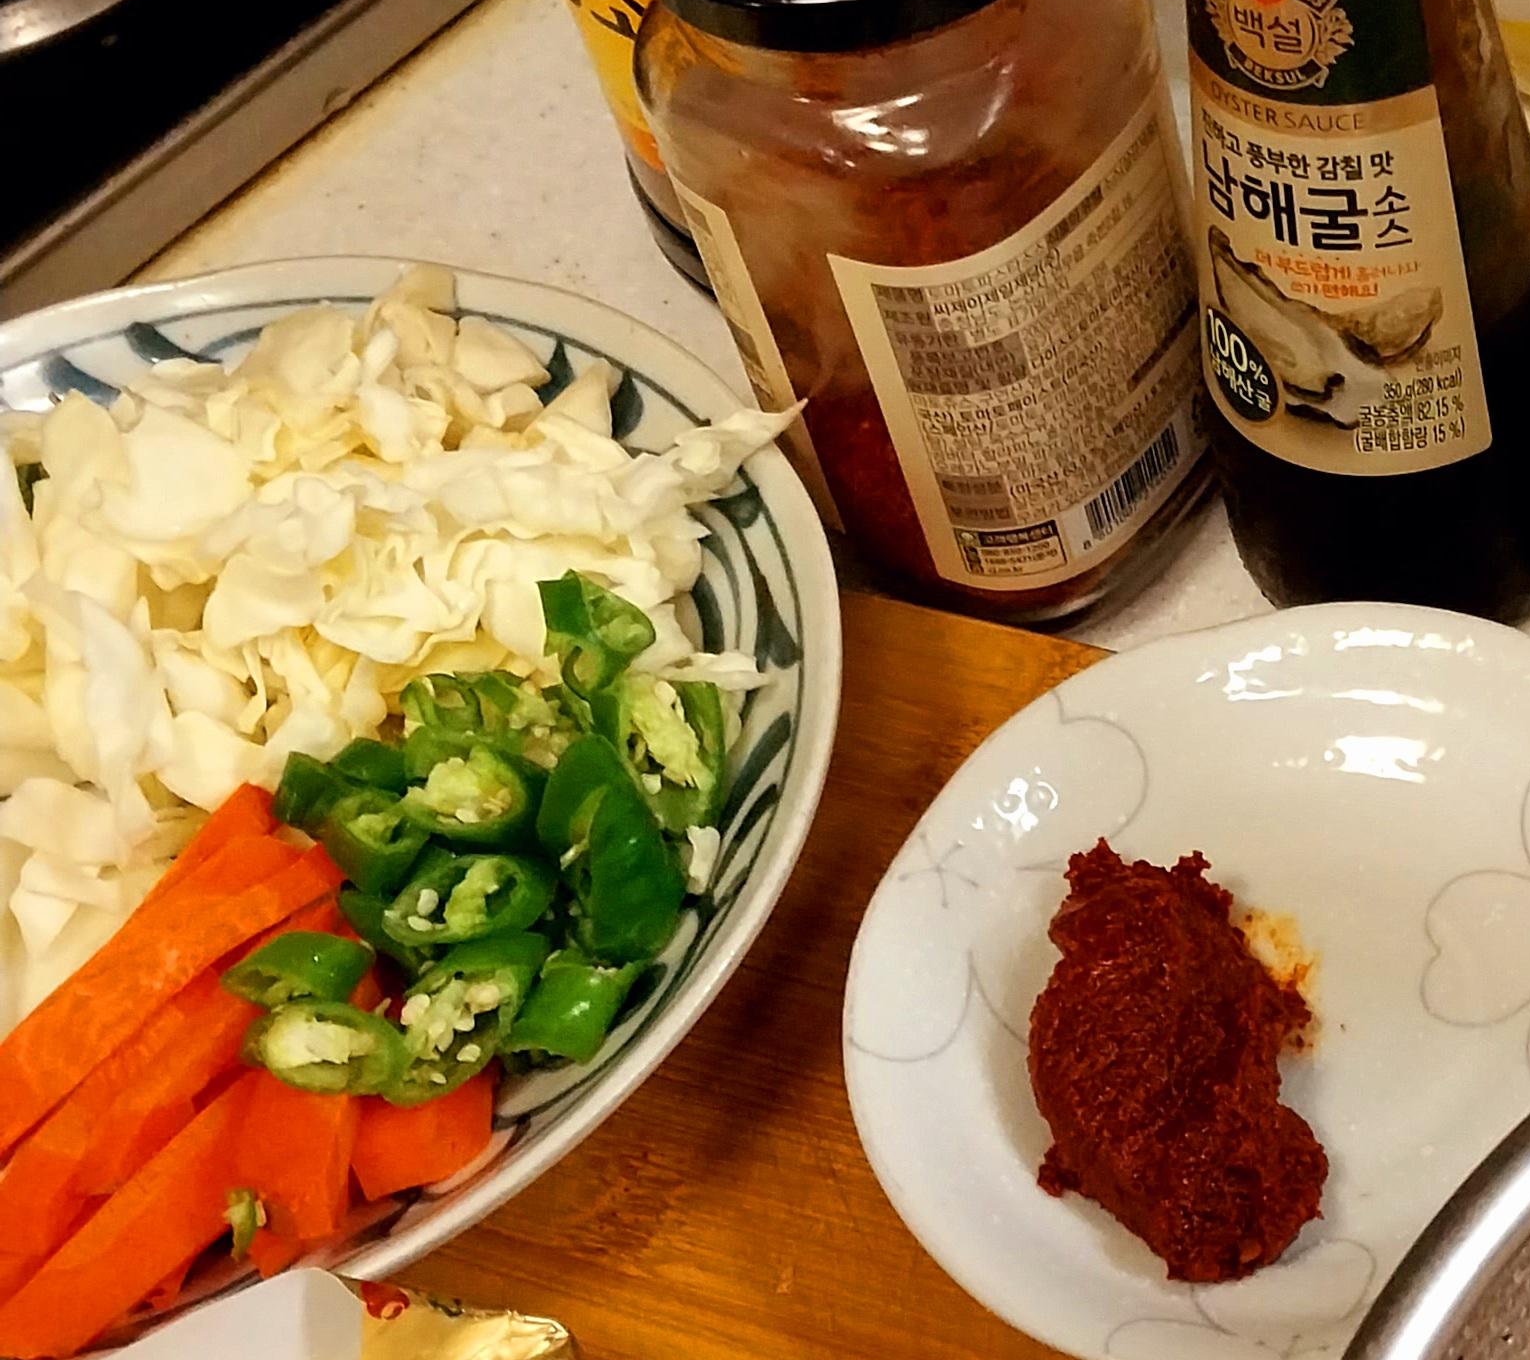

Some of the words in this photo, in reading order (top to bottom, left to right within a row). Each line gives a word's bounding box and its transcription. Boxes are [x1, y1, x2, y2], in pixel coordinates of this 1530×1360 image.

[1233, 5, 1303, 55] 백설
[1210, 79, 1280, 127] OYSTER
[1283, 111, 1367, 133] SAUCE
[1246, 140, 1311, 180] 풍부한
[1315, 154, 1364, 182] 감칠
[1369, 149, 1395, 179] 맛
[1201, 138, 1370, 252] 남해굴
[1372, 185, 1415, 250] 소스
[1207, 308, 1270, 387] 100%
[1209, 342, 1255, 406] 남해산
[1254, 388, 1272, 415] 굴
[1436, 366, 1463, 392] kcal)
[1416, 397, 1449, 424] 82.15
[1450, 394, 1465, 412] %
[1431, 422, 1447, 444] 15
[1448, 415, 1467, 440] %)
